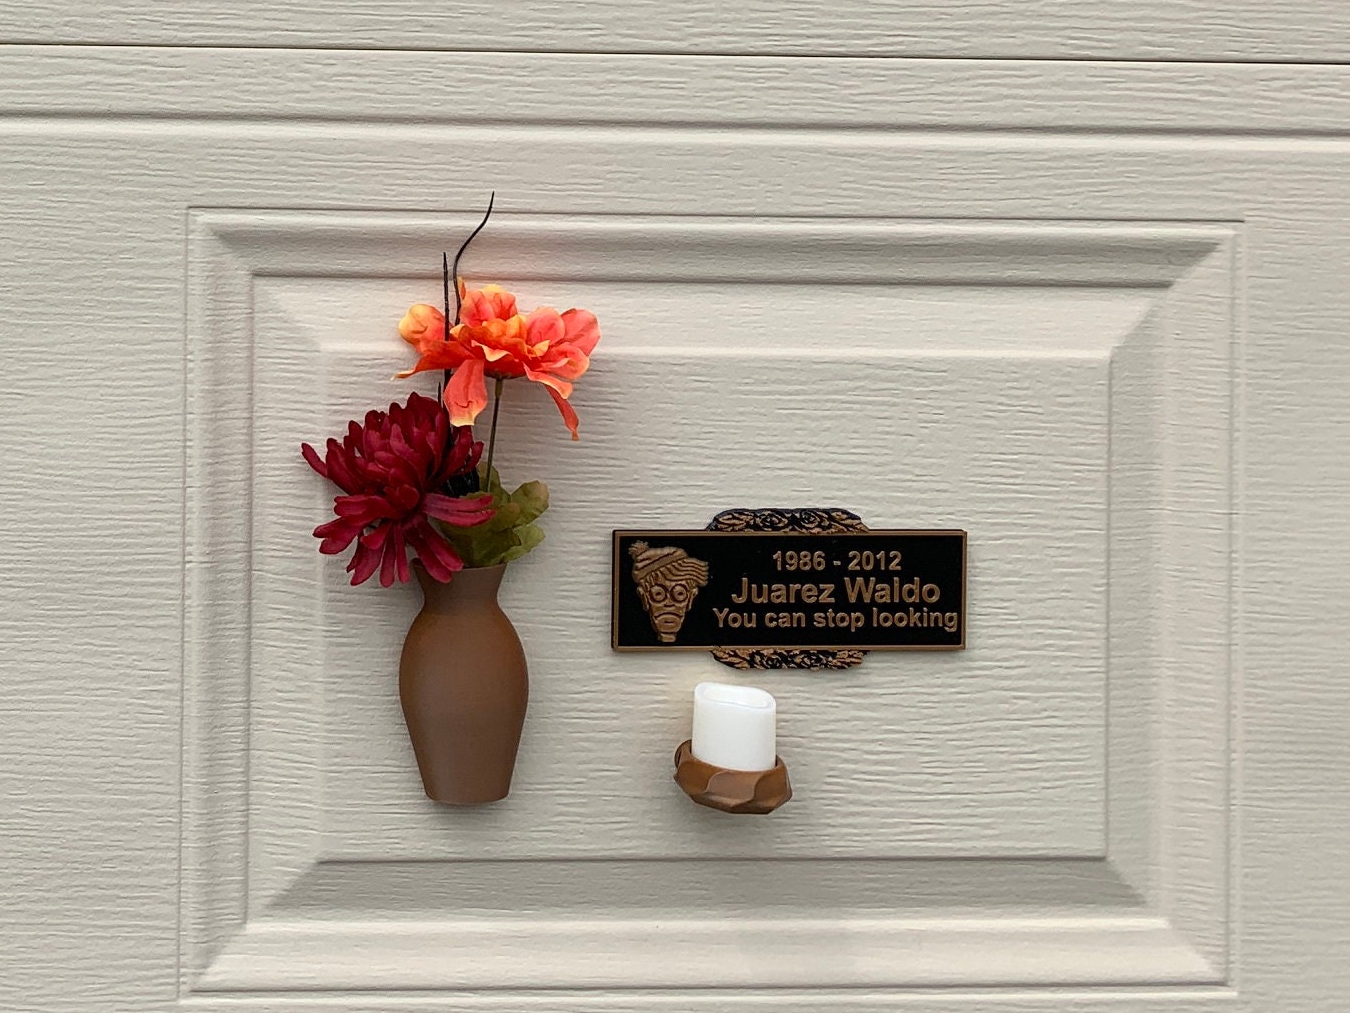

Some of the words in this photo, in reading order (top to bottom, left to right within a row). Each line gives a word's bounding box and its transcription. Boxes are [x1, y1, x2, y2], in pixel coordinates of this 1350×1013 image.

[772, 551, 825, 570] 1986
[848, 550, 902, 570] 2012
[731, 577, 835, 604] Juarez
[844, 577, 941, 604] Waldo
[712, 608, 756, 628] You
[764, 612, 806, 627] can
[814, 610, 864, 632] stop
[872, 608, 958, 632] looking
